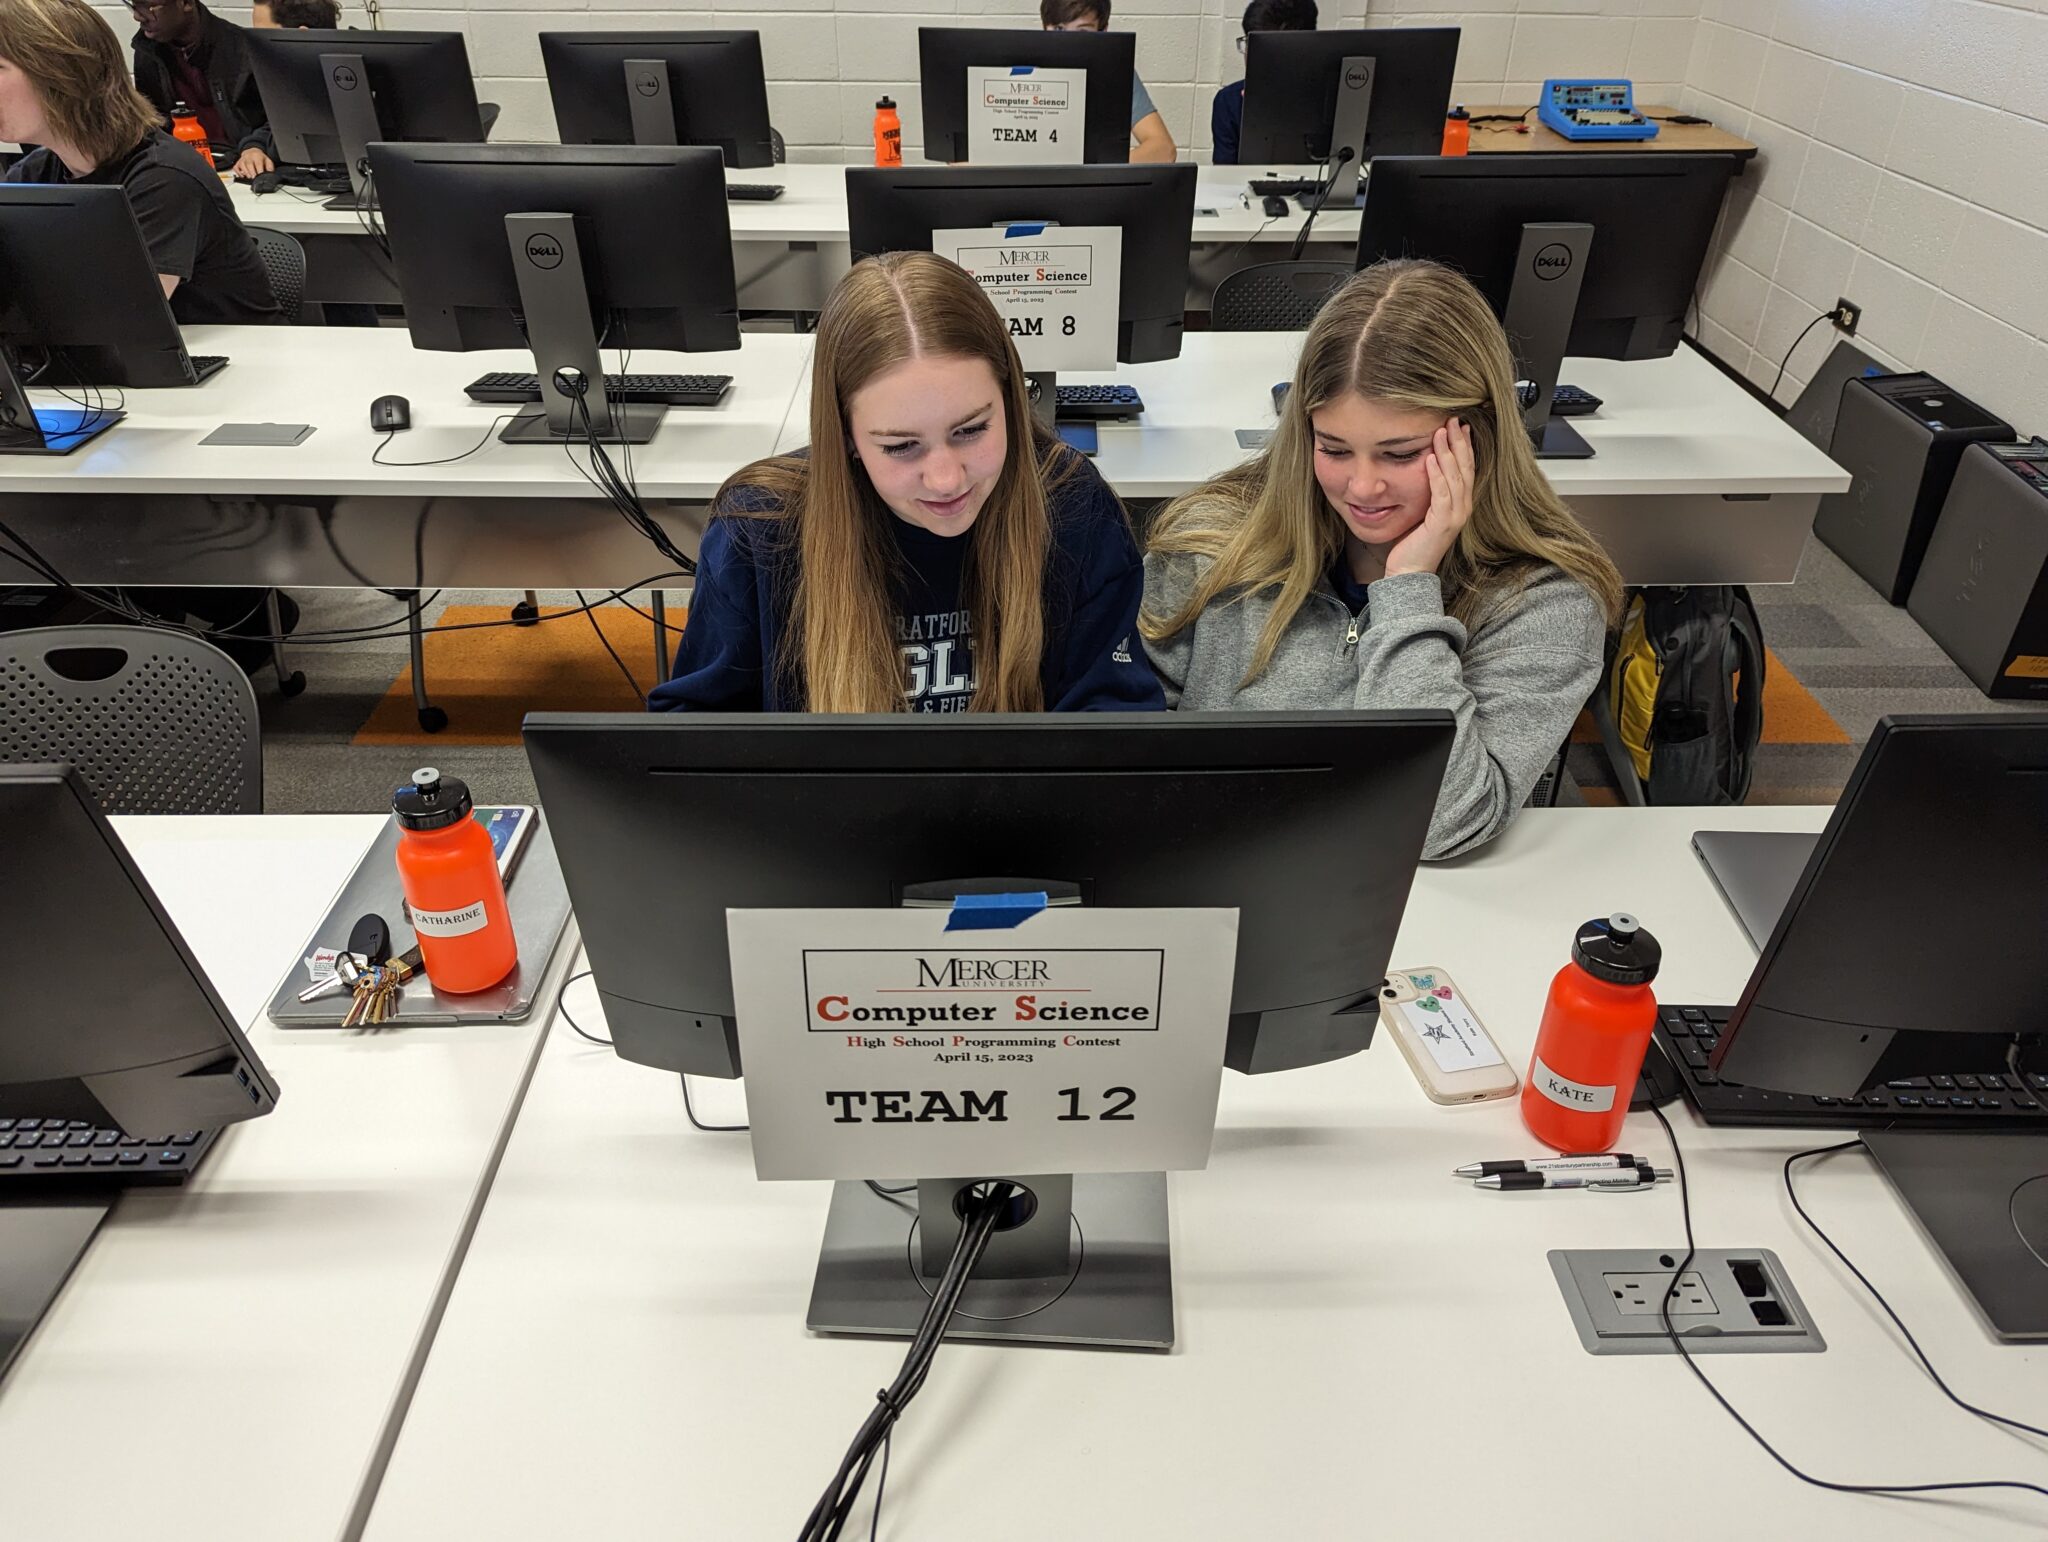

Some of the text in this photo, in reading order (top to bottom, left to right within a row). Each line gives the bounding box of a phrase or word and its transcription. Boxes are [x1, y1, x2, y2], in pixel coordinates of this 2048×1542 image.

[986, 94, 1066, 106] Computer Science
[992, 128, 1058, 143] TEAM 4
[529, 246, 559, 256] DELL
[999, 250, 1050, 265] MERCER
[1537, 257, 1567, 267] DELL
[1036, 268, 1088, 282] Science
[1013, 288, 1053, 296] Programming
[1004, 315, 1076, 336] AM 8
[896, 610, 974, 640] RATFOR
[415, 908, 481, 925] CATHARINE
[915, 958, 1052, 988] MERCER
[816, 995, 1150, 1027] Computer Science
[847, 1034, 1121, 1049] High School Programming Contest
[933, 1052, 1034, 1063] April 15, 2023
[1548, 1078, 1595, 1103] KATE
[826, 1086, 1137, 1123] TEAM 12
